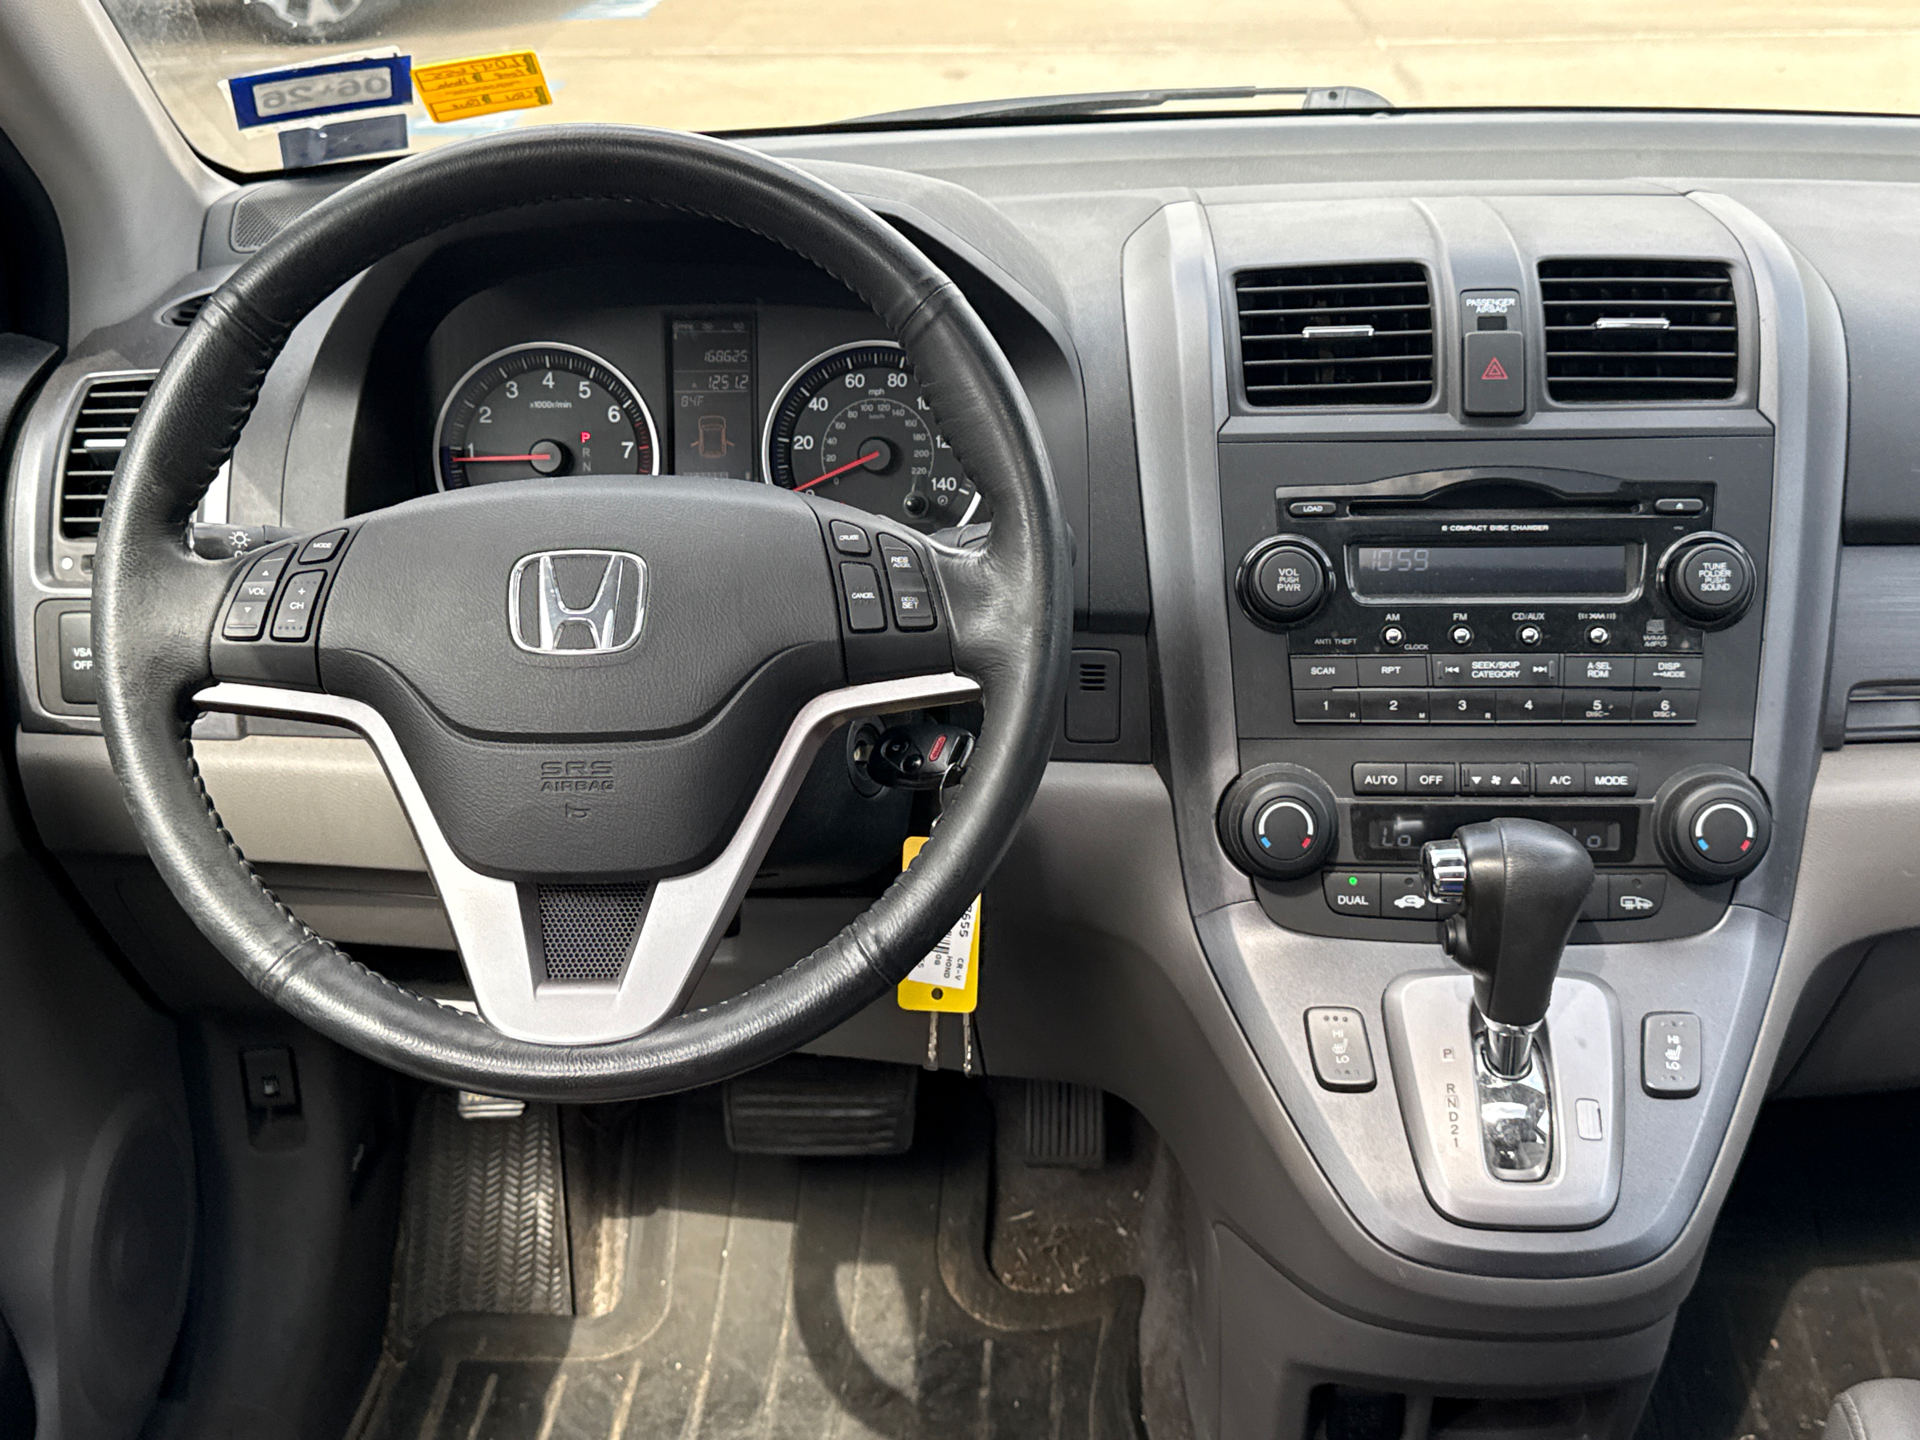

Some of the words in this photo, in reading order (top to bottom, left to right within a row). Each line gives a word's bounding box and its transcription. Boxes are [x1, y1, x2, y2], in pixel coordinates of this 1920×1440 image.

[1466, 298, 1515, 306] PASSENGER
[704, 350, 748, 362] 168625
[542, 371, 554, 389] 4
[845, 374, 865, 388] 60
[887, 373, 908, 388] 80
[506, 381, 519, 399] 3
[578, 381, 591, 399] 5
[868, 388, 885, 397] mph
[808, 397, 828, 412] 40
[860, 404, 874, 412] 100
[877, 404, 890, 412] 120
[479, 406, 492, 423] 2
[608, 405, 620, 423] 6
[848, 410, 858, 418] 80
[892, 408, 905, 417] 140
[835, 422, 846, 430] 60
[904, 420, 917, 428] 160
[581, 432, 591, 443] P
[827, 437, 837, 445] 40
[913, 434, 926, 442] 180
[793, 436, 814, 450] 20
[468, 443, 474, 458] 1
[582, 448, 590, 457] R
[621, 442, 634, 459] 7
[914, 450, 930, 458] 200
[826, 454, 836, 462] 20
[583, 462, 591, 472] N
[912, 467, 927, 475] 220
[931, 477, 957, 491] 140
[1490, 524, 1509, 532] DISC
[1511, 524, 1549, 532] CHANGER
[1702, 562, 1727, 570] TUNE
[1278, 568, 1300, 577] VOL
[1698, 570, 1731, 578] FOLDER
[248, 588, 266, 596] VOL
[1276, 583, 1301, 592] PWR
[1700, 584, 1730, 592] SOUND
[290, 602, 304, 610] CH
[1385, 613, 1400, 622] AM
[1452, 613, 1468, 621] FM
[1512, 612, 1545, 620] CD/AUX
[74, 648, 92, 656] VSA
[74, 660, 93, 670] OFF
[1472, 662, 1520, 670] SEEK/SKIP
[1658, 662, 1681, 670] DISP
[1310, 666, 1336, 675] SCAN
[1381, 666, 1402, 674] RPT
[1472, 670, 1520, 678] CATEGORY
[1323, 700, 1328, 710] 1
[1389, 700, 1398, 710] 2
[1458, 700, 1467, 710] 3
[1524, 700, 1533, 710] 4
[1592, 700, 1602, 710] 5
[1660, 700, 1670, 710] 6
[540, 761, 613, 776] SRS
[1364, 775, 1398, 784] AUTO
[1419, 775, 1443, 785] OFF
[1550, 776, 1572, 785] A/C
[1594, 776, 1628, 786] MODE
[540, 780, 615, 792] AIRBAG
[1338, 895, 1369, 905] DUAL
[943, 955, 954, 979] HOND
[954, 957, 964, 981] CR-V
[1332, 1029, 1344, 1038] HI
[1443, 1048, 1452, 1059] P
[1336, 1055, 1350, 1064] LO
[1446, 1084, 1456, 1094] R
[1448, 1098, 1456, 1108] N
[1449, 1112, 1458, 1122] D
[1450, 1124, 1459, 1134] 2
[1454, 1138, 1458, 1148] 1
